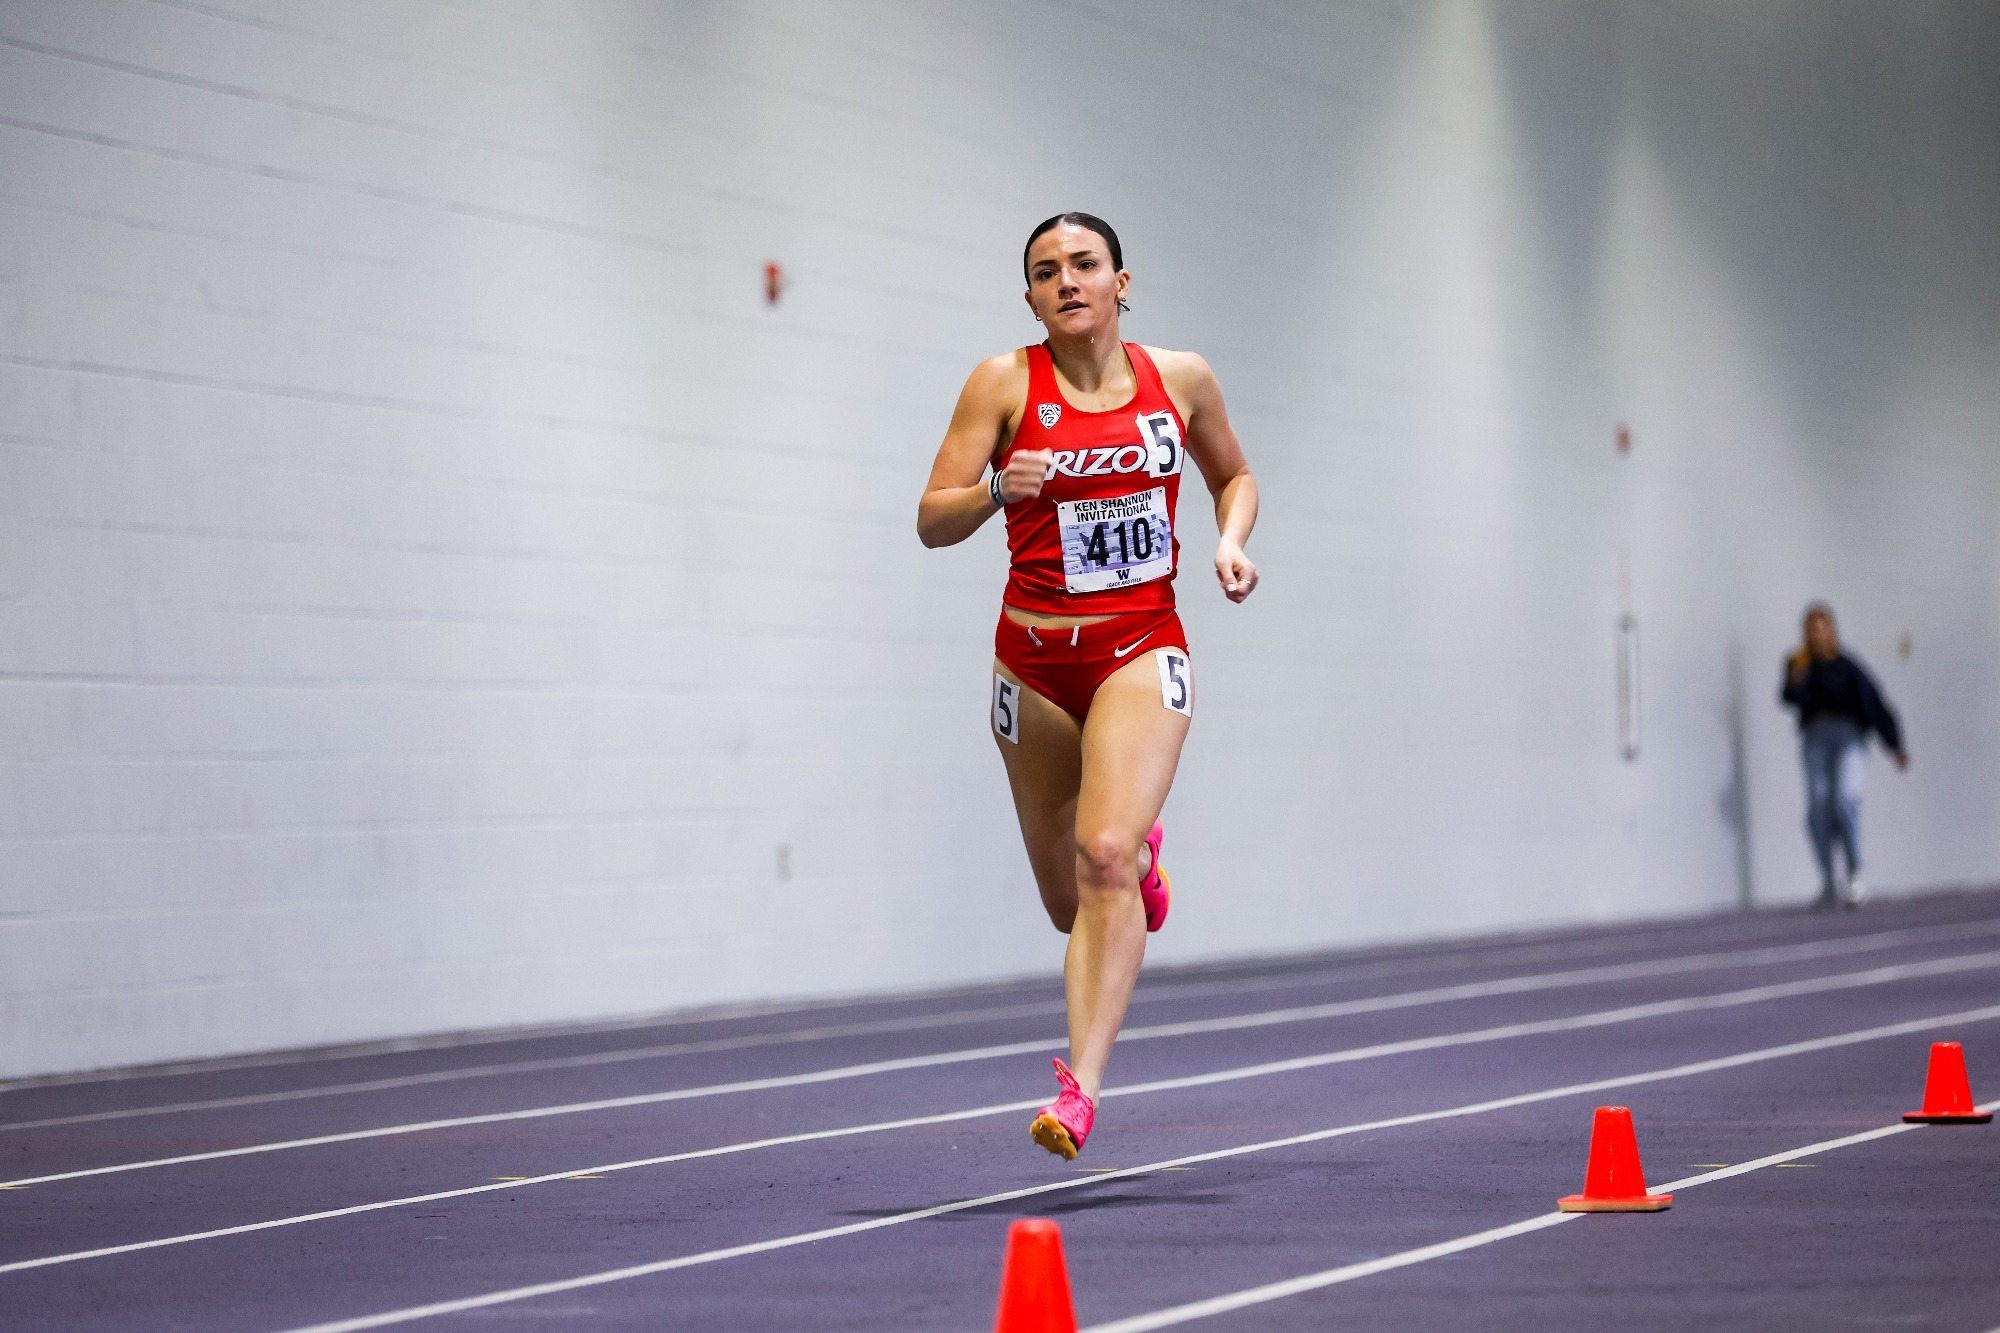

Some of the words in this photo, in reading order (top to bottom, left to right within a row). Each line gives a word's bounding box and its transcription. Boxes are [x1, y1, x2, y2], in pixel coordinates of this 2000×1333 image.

[1045, 416, 1054, 424] 12
[1044, 445, 1150, 481] RIZO
[1148, 417, 1176, 473] 5
[1074, 501, 1098, 513] KEN
[1101, 491, 1152, 509] SHANNON
[1077, 502, 1152, 522] INVITATIONAL
[1087, 517, 1152, 567] 410
[1116, 568, 1131, 581] W
[1167, 655, 1187, 710] 5
[998, 681, 1012, 737] 5
